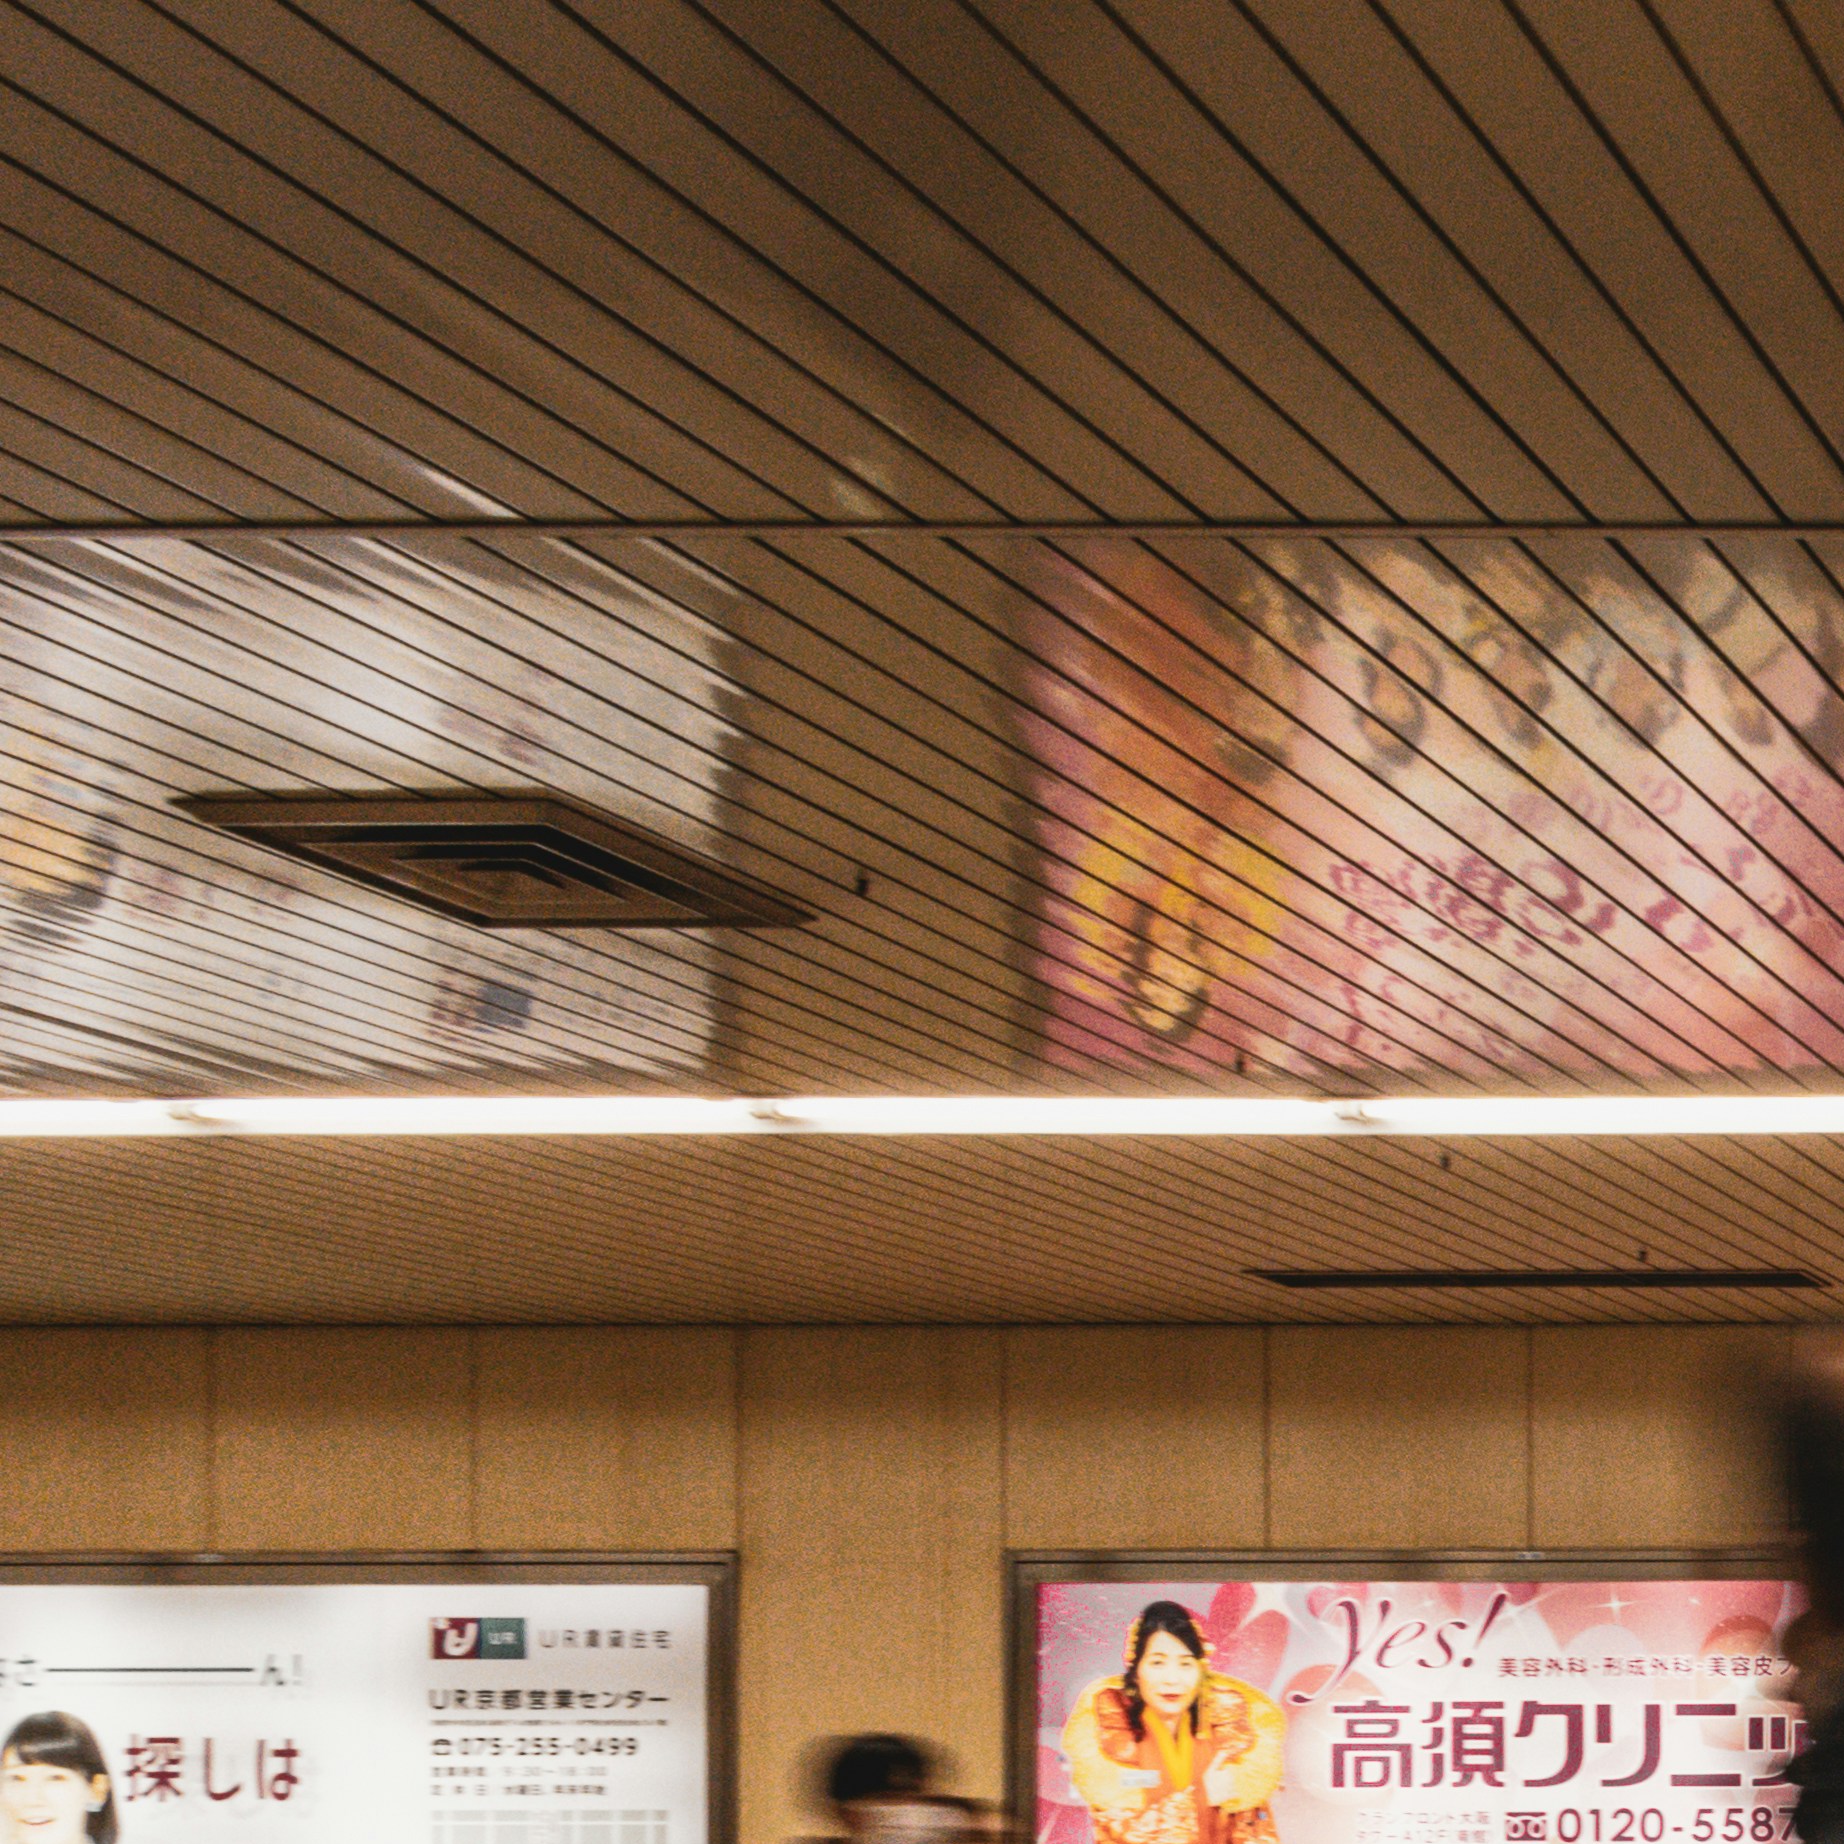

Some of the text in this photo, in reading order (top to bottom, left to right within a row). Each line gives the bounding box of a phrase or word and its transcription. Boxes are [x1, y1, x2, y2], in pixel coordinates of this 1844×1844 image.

[1290, 1592, 1505, 1703] Yes!
[1499, 1656, 1791, 1677] 美容外科・形成外科・美容皮フ
[1332, 1699, 1808, 1787] 高須クリニッ
